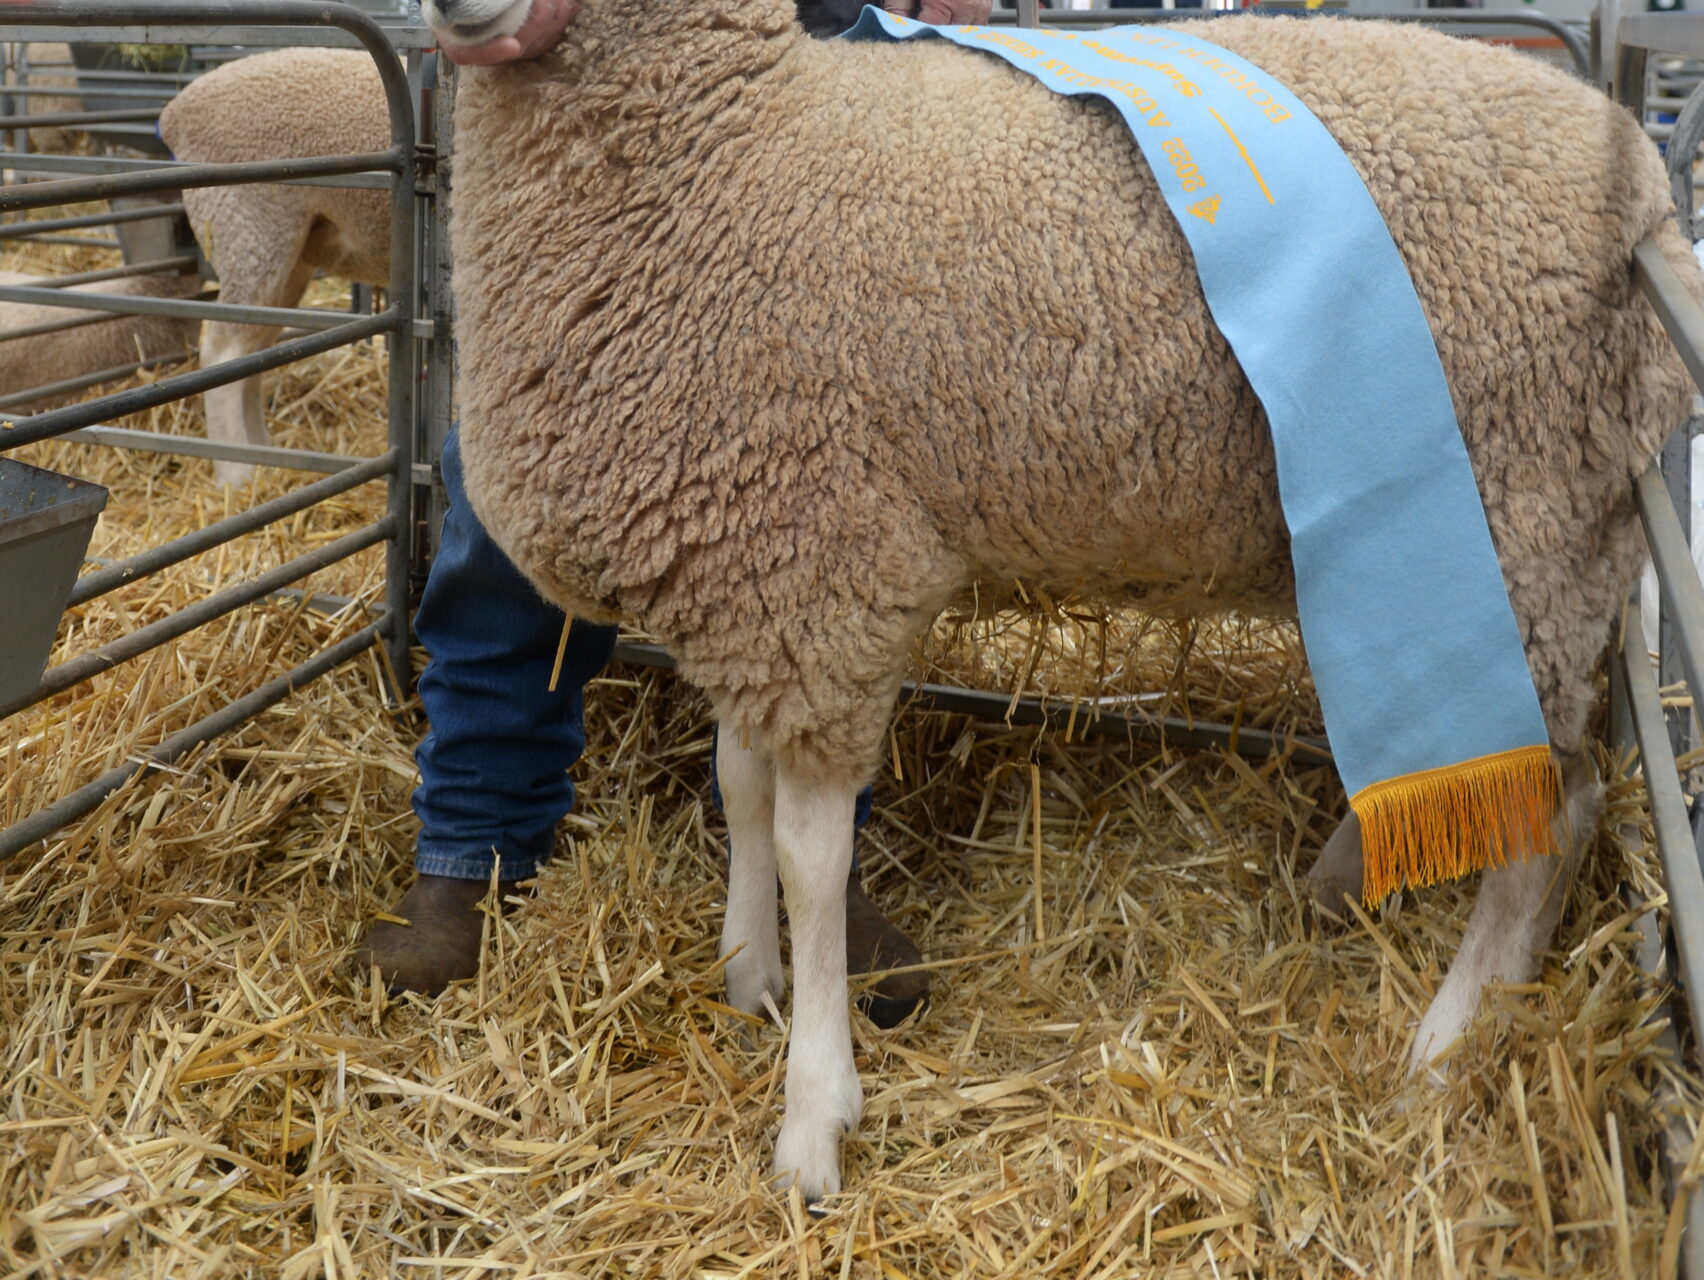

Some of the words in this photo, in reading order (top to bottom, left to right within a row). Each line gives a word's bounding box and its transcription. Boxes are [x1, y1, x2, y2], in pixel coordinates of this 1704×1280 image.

[1081, 39, 1202, 98] Supreme
[1178, 47, 1293, 125] BORDER
[1162, 137, 1207, 193] 2022
